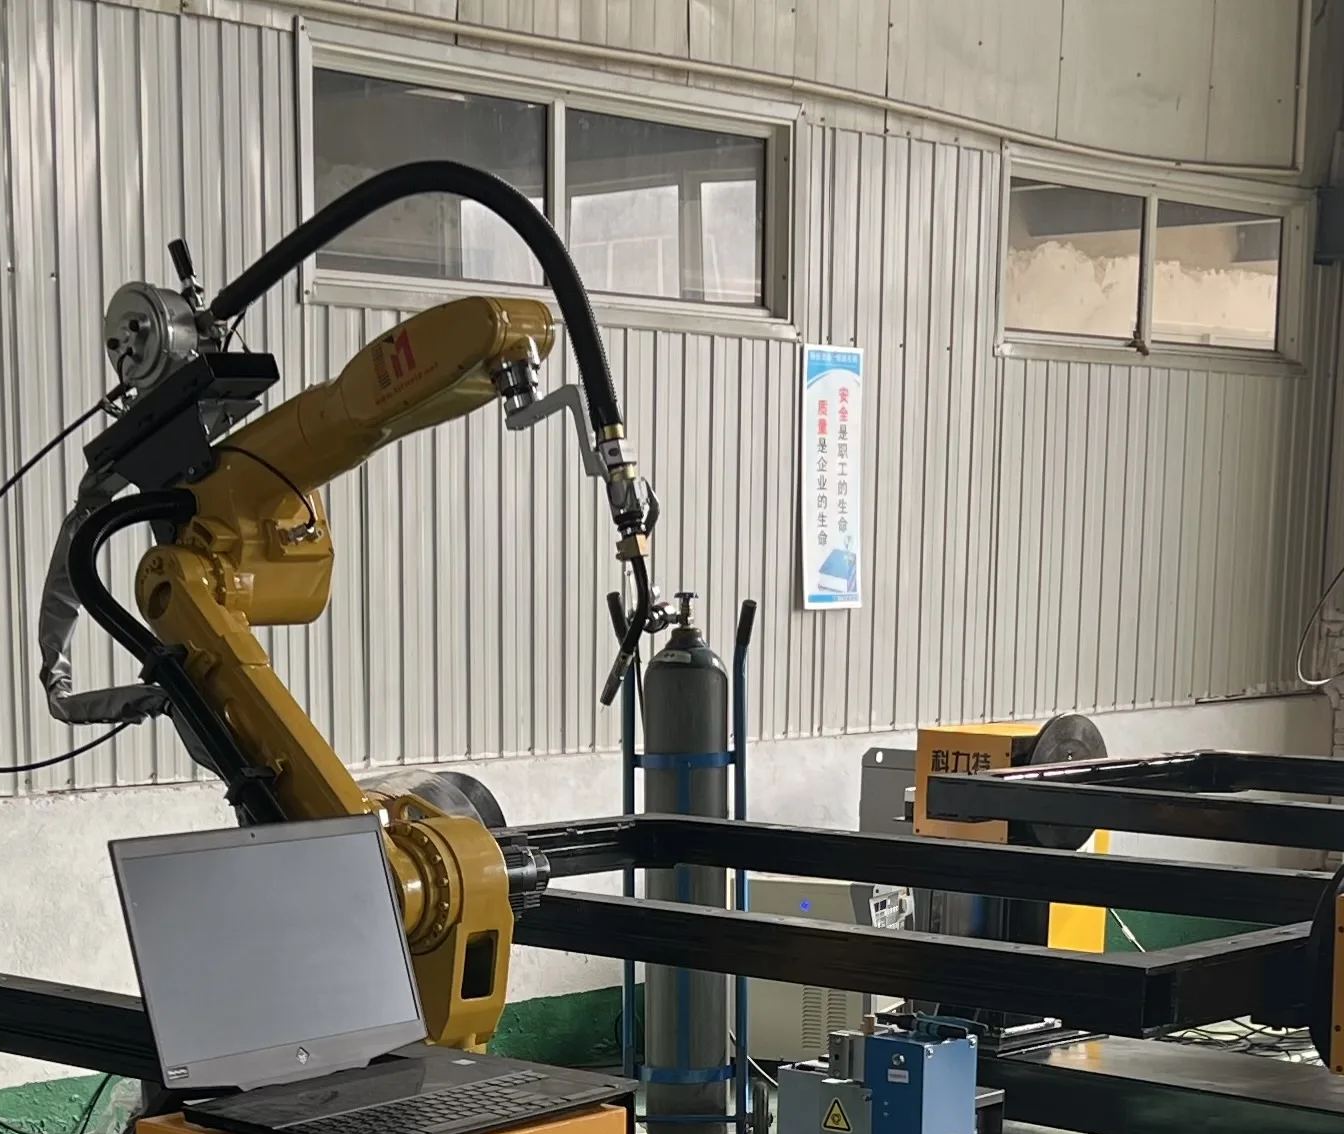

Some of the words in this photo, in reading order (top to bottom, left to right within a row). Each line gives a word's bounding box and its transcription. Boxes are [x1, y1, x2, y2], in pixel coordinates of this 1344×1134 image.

[817, 400, 828, 546] 质量是企业的生命
[837, 386, 849, 533] 安全是职工的生命
[931, 749, 991, 775] 科力特
